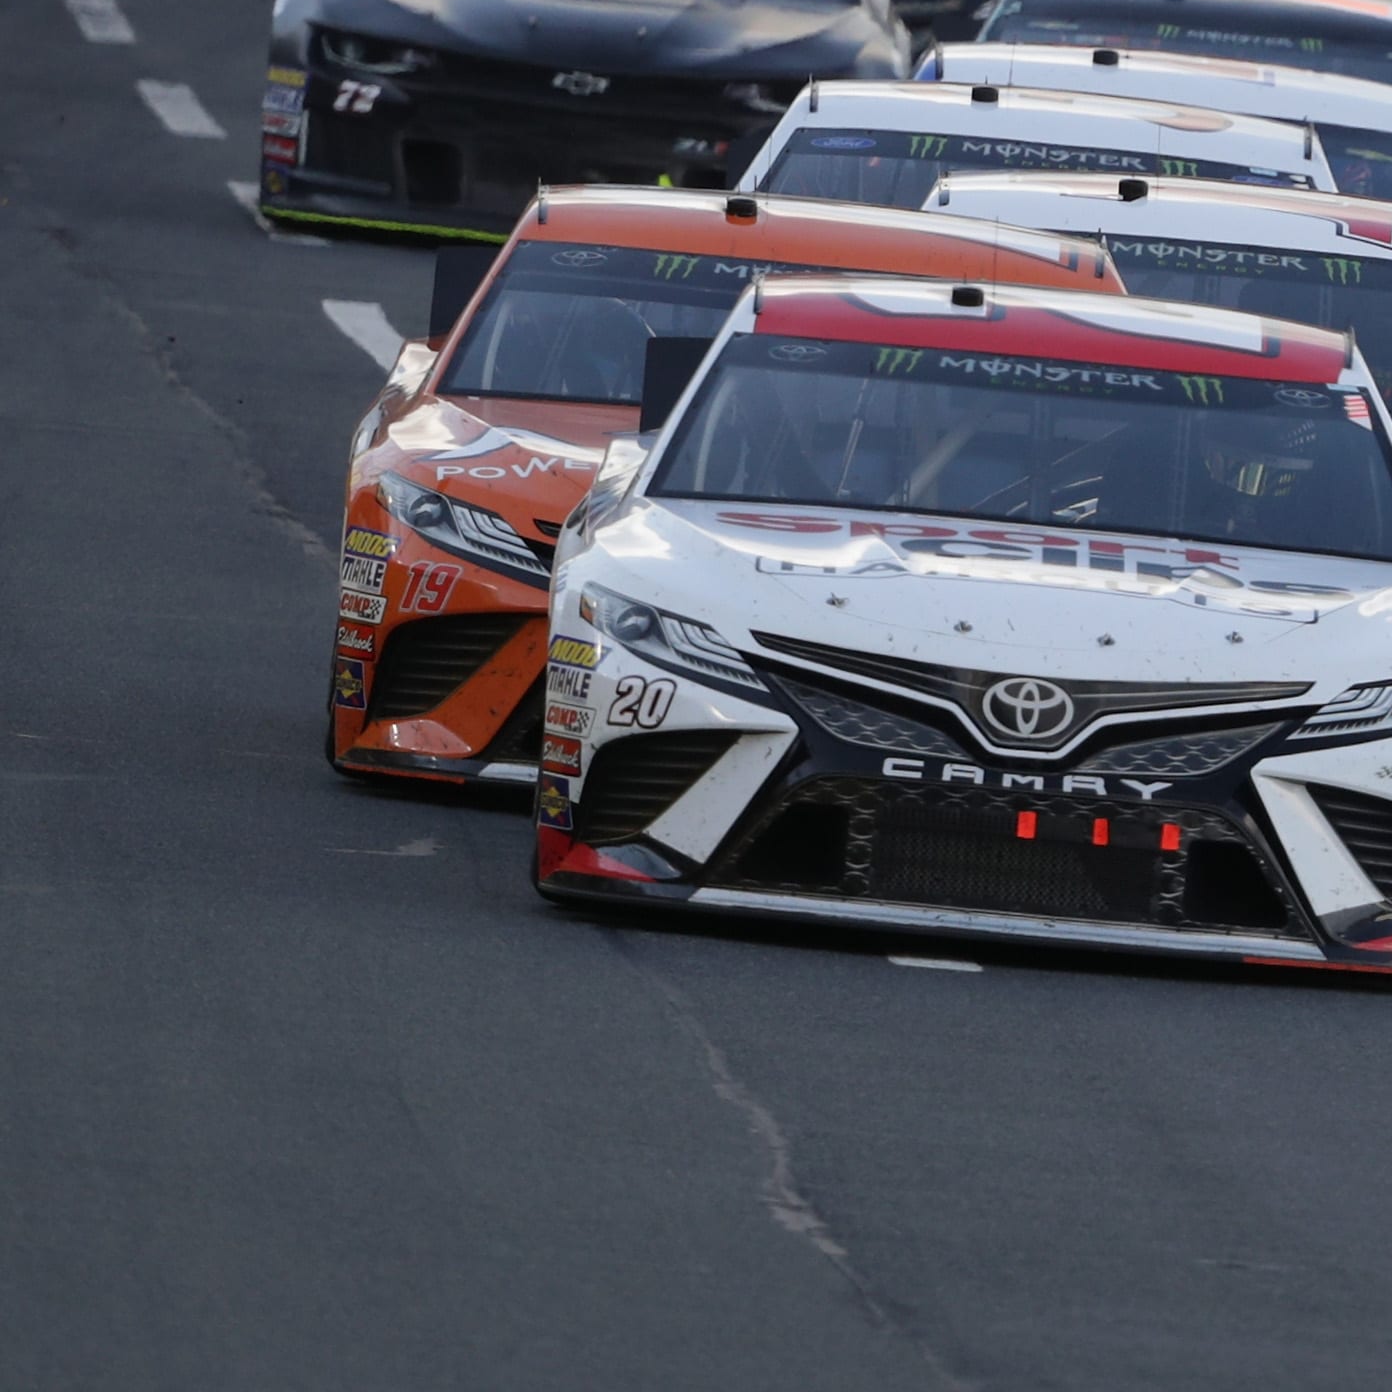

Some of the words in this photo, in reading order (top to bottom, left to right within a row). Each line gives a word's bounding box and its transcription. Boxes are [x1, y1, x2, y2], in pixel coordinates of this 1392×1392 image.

[1111, 240, 1308, 270] MONSTER
[938, 355, 1164, 390] MONSTER
[342, 557, 384, 588] MAHLE
[398, 559, 464, 614] 19
[606, 674, 678, 730] 20
[881, 757, 1174, 801] CAMRY
